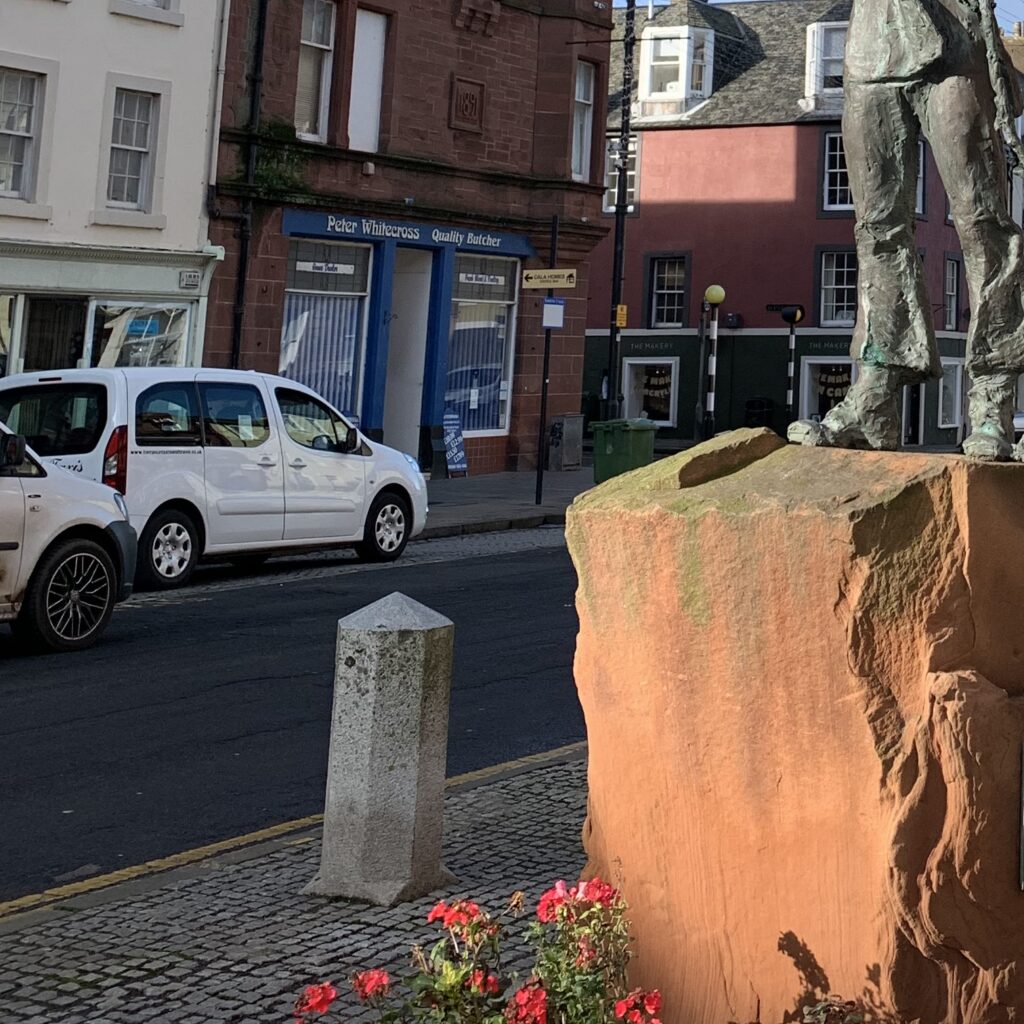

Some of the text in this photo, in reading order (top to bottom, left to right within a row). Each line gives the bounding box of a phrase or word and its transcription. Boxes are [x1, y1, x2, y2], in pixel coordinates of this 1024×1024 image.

[326, 215, 501, 247] Peter Whitecross Quality Butcher
[645, 342, 673, 350] MAKERY
